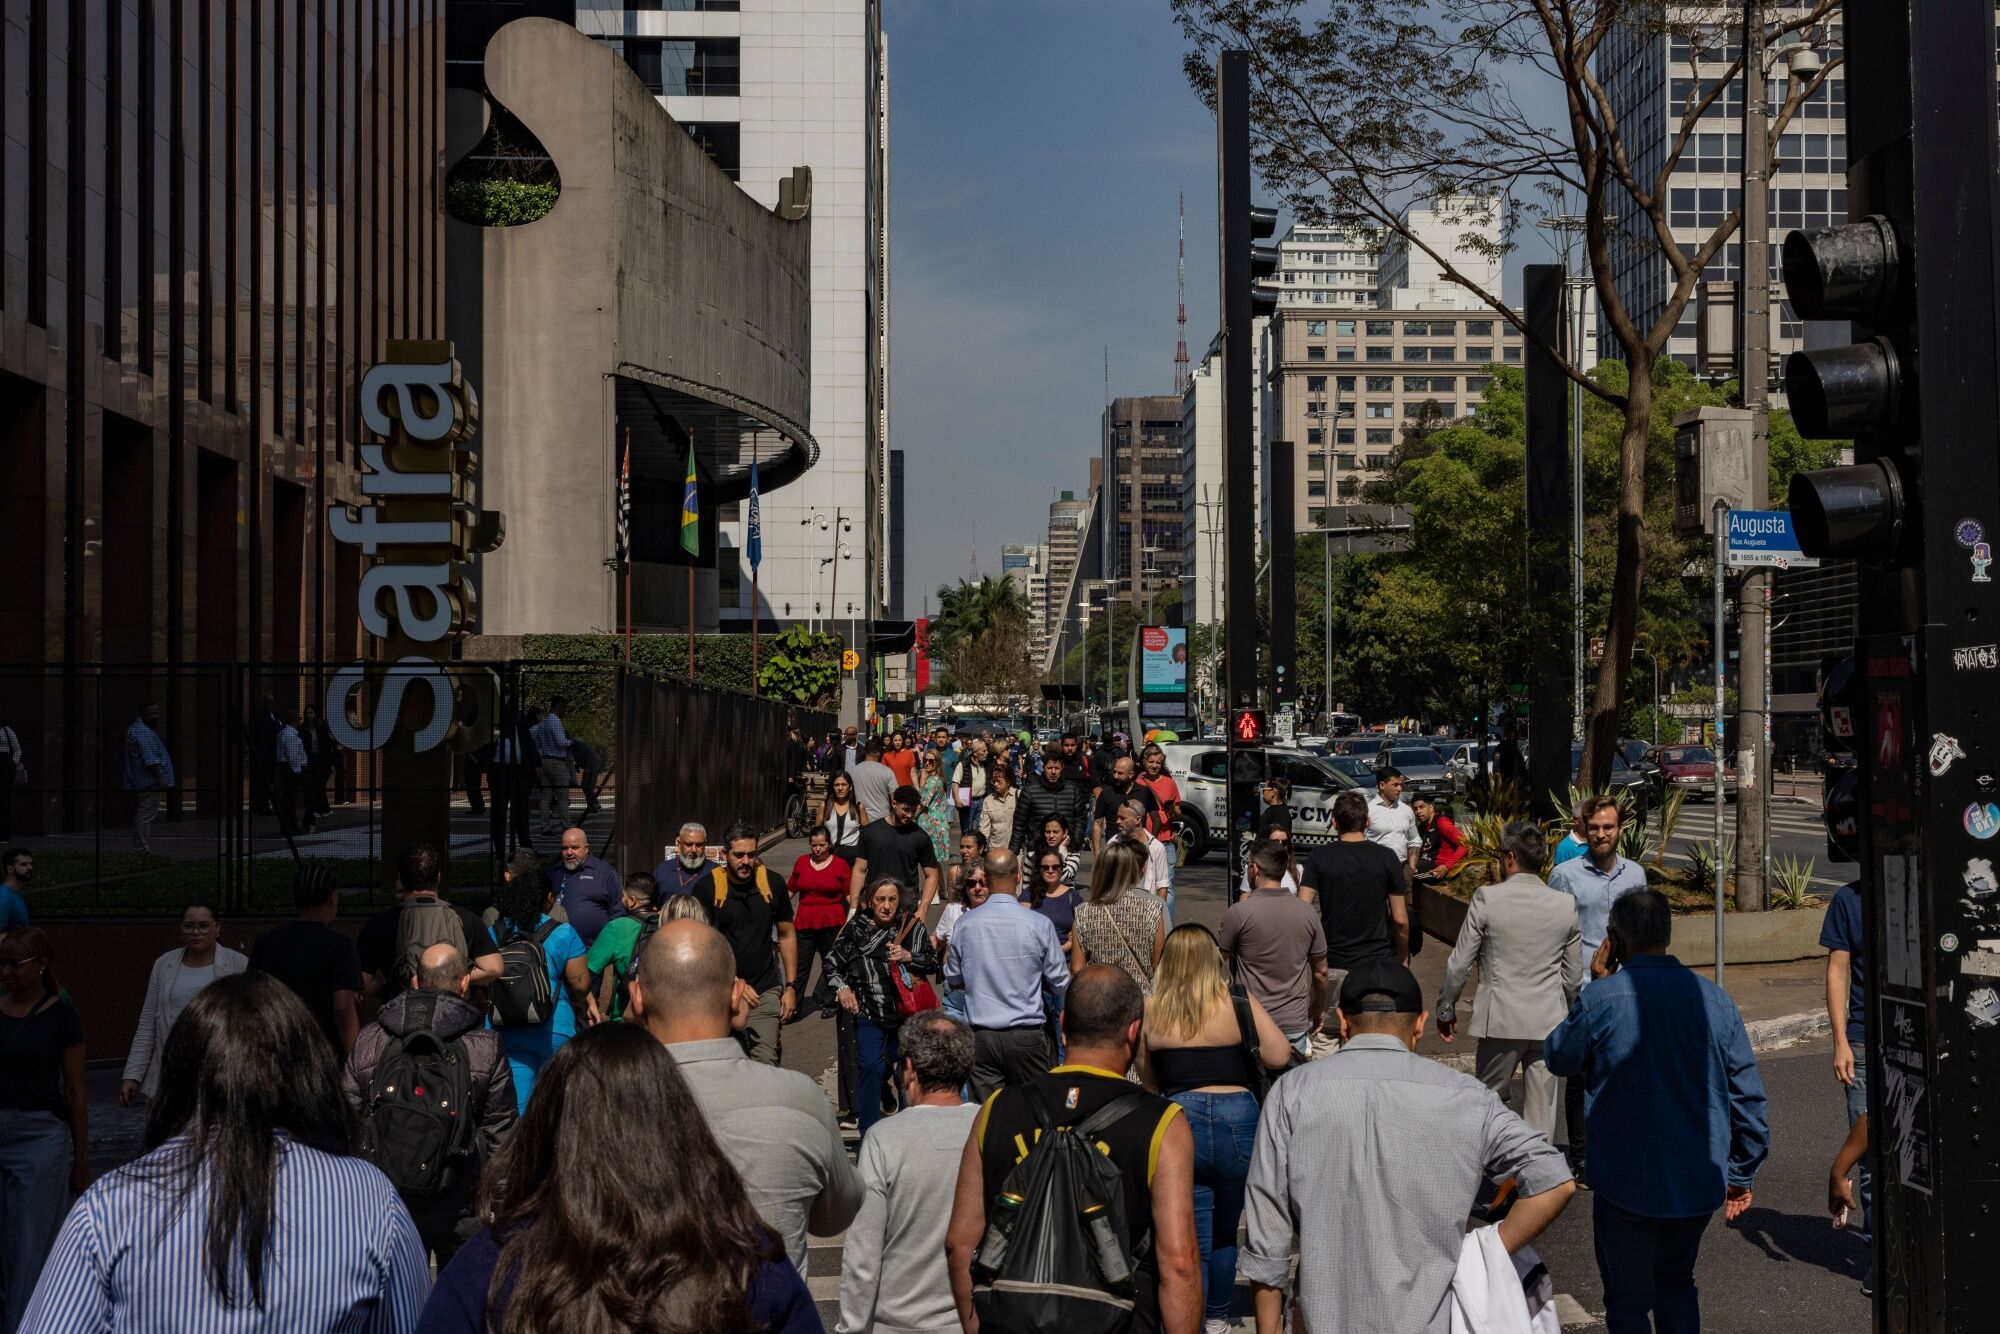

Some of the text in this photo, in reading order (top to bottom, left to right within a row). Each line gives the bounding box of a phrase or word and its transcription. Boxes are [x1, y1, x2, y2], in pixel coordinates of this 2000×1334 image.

[1730, 514, 1785, 537] Augusta
[1743, 538, 1767, 547] Augusta
[326, 358, 455, 753] Safra
[1287, 806, 1333, 822] GCM
